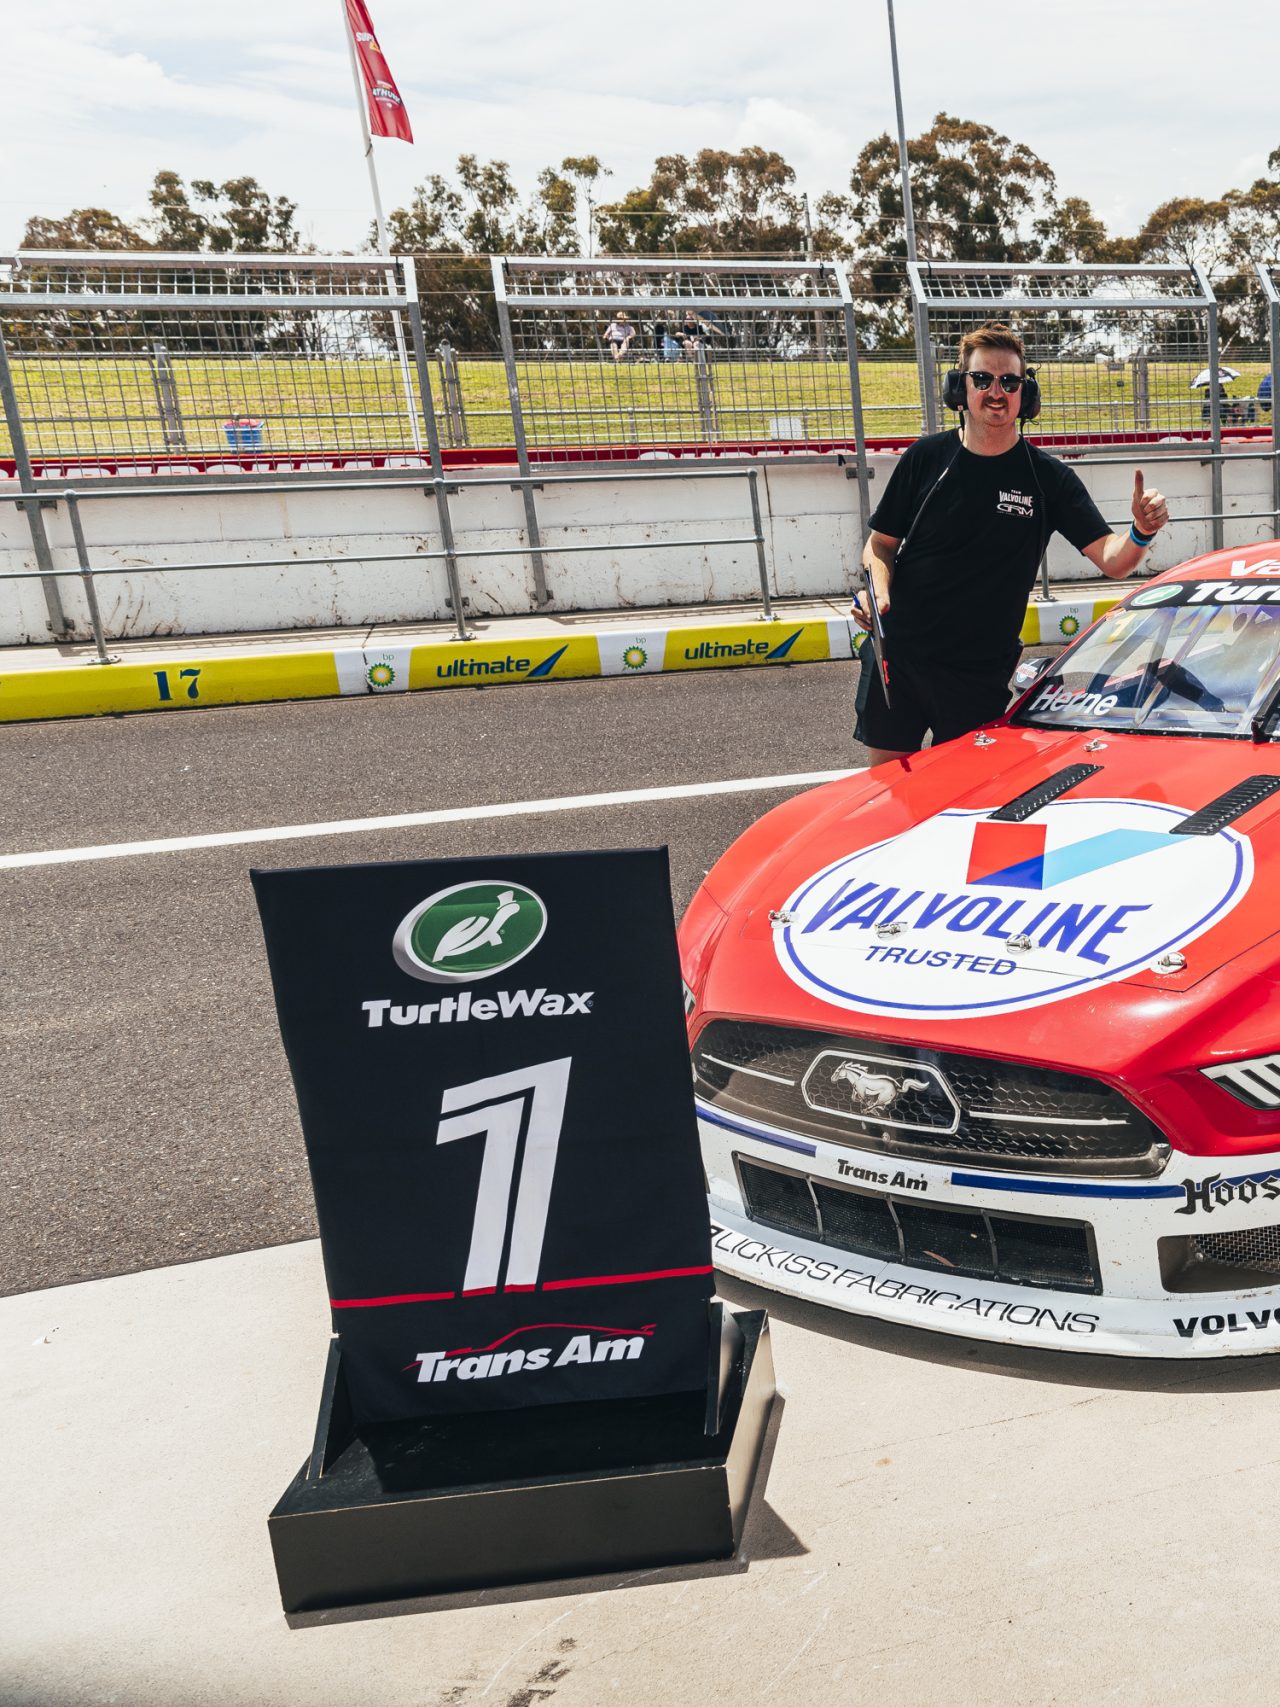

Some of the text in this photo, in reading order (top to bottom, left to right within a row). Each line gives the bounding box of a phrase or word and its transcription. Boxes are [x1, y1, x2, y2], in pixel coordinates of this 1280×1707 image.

[999, 490, 1034, 507] VALVOLINE
[1069, 606, 1079, 614] bp
[635, 636, 647, 645] bp
[684, 638, 769, 661] ultimate
[382, 652, 395, 662] bp
[436, 655, 531, 678] ultimate
[153, 668, 201, 701] 17
[1028, 684, 1118, 716] Herne
[800, 877, 1154, 966] VALVOLINE
[867, 945, 1018, 976] TRUSTED
[361, 988, 595, 1028] TurtleWax
[436, 1056, 572, 1296] 1
[837, 1158, 929, 1192] Trans Am
[415, 1334, 645, 1383] Trans Am
